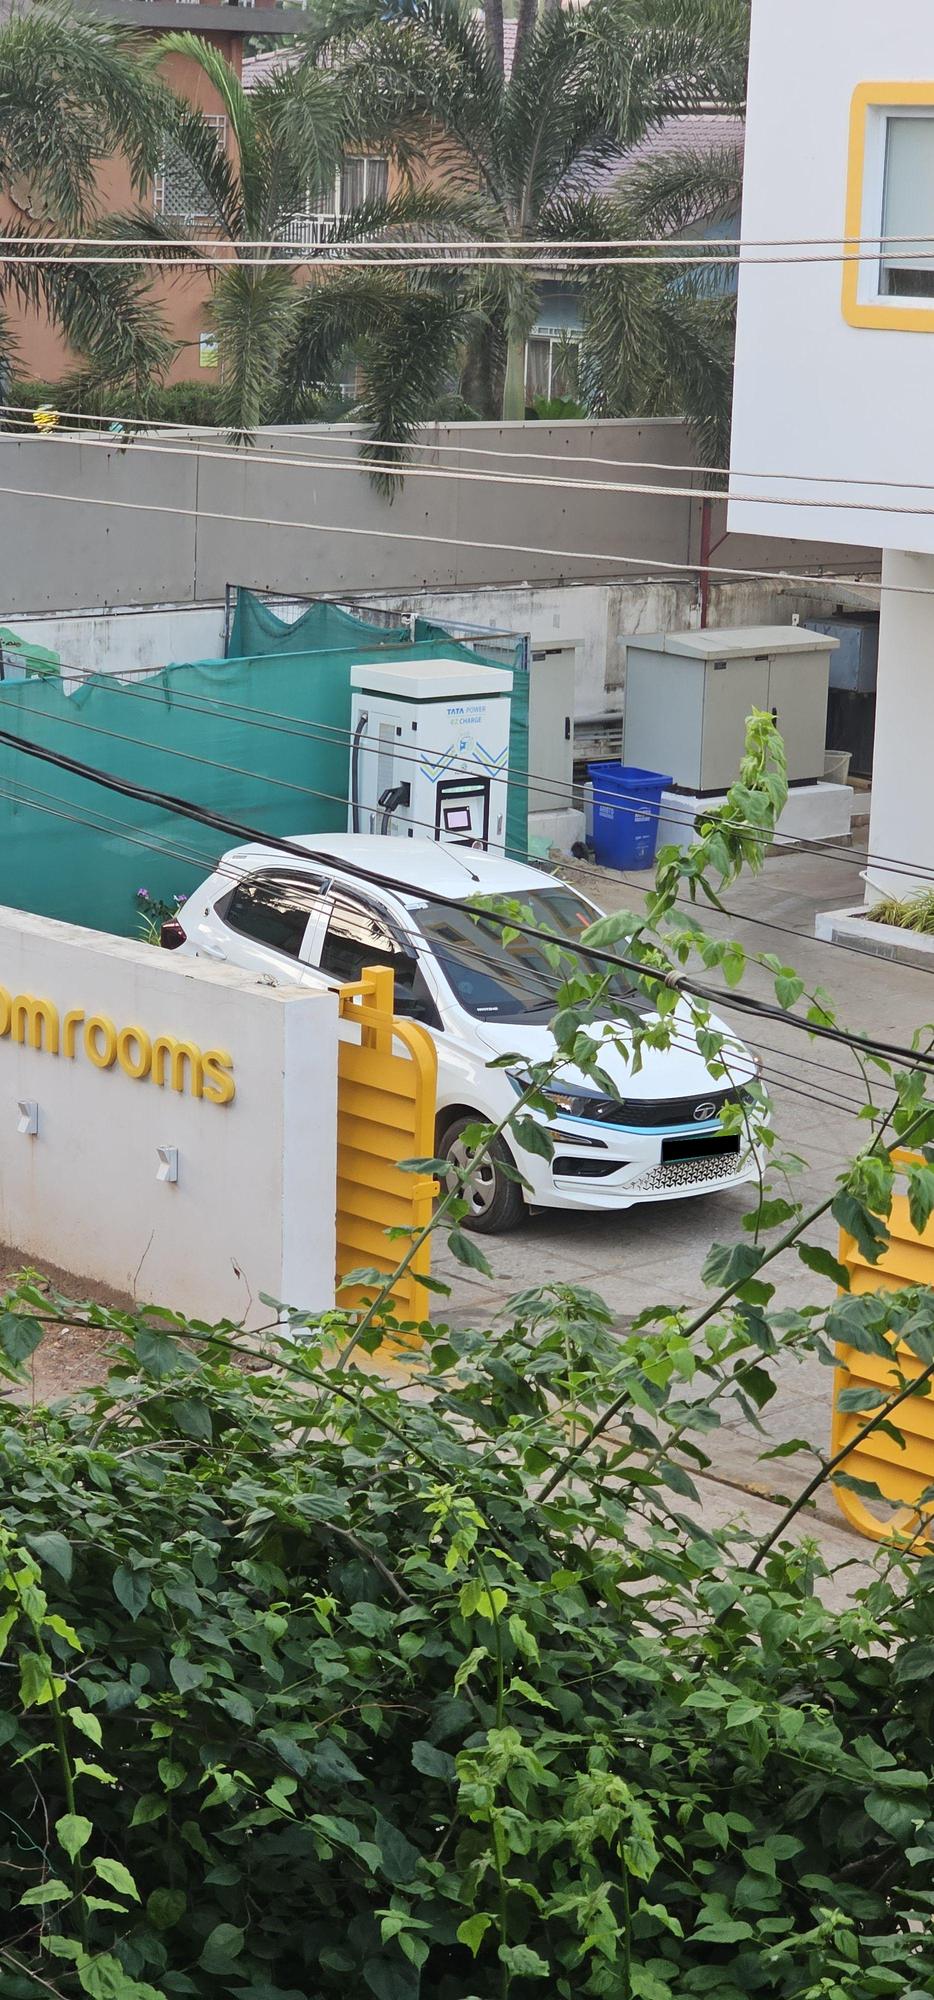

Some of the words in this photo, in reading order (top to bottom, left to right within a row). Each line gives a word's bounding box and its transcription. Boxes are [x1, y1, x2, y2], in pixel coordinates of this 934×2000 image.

[447, 707, 464, 715] TATA
[466, 705, 486, 713] POWER
[459, 716, 481, 724] CHARGE
